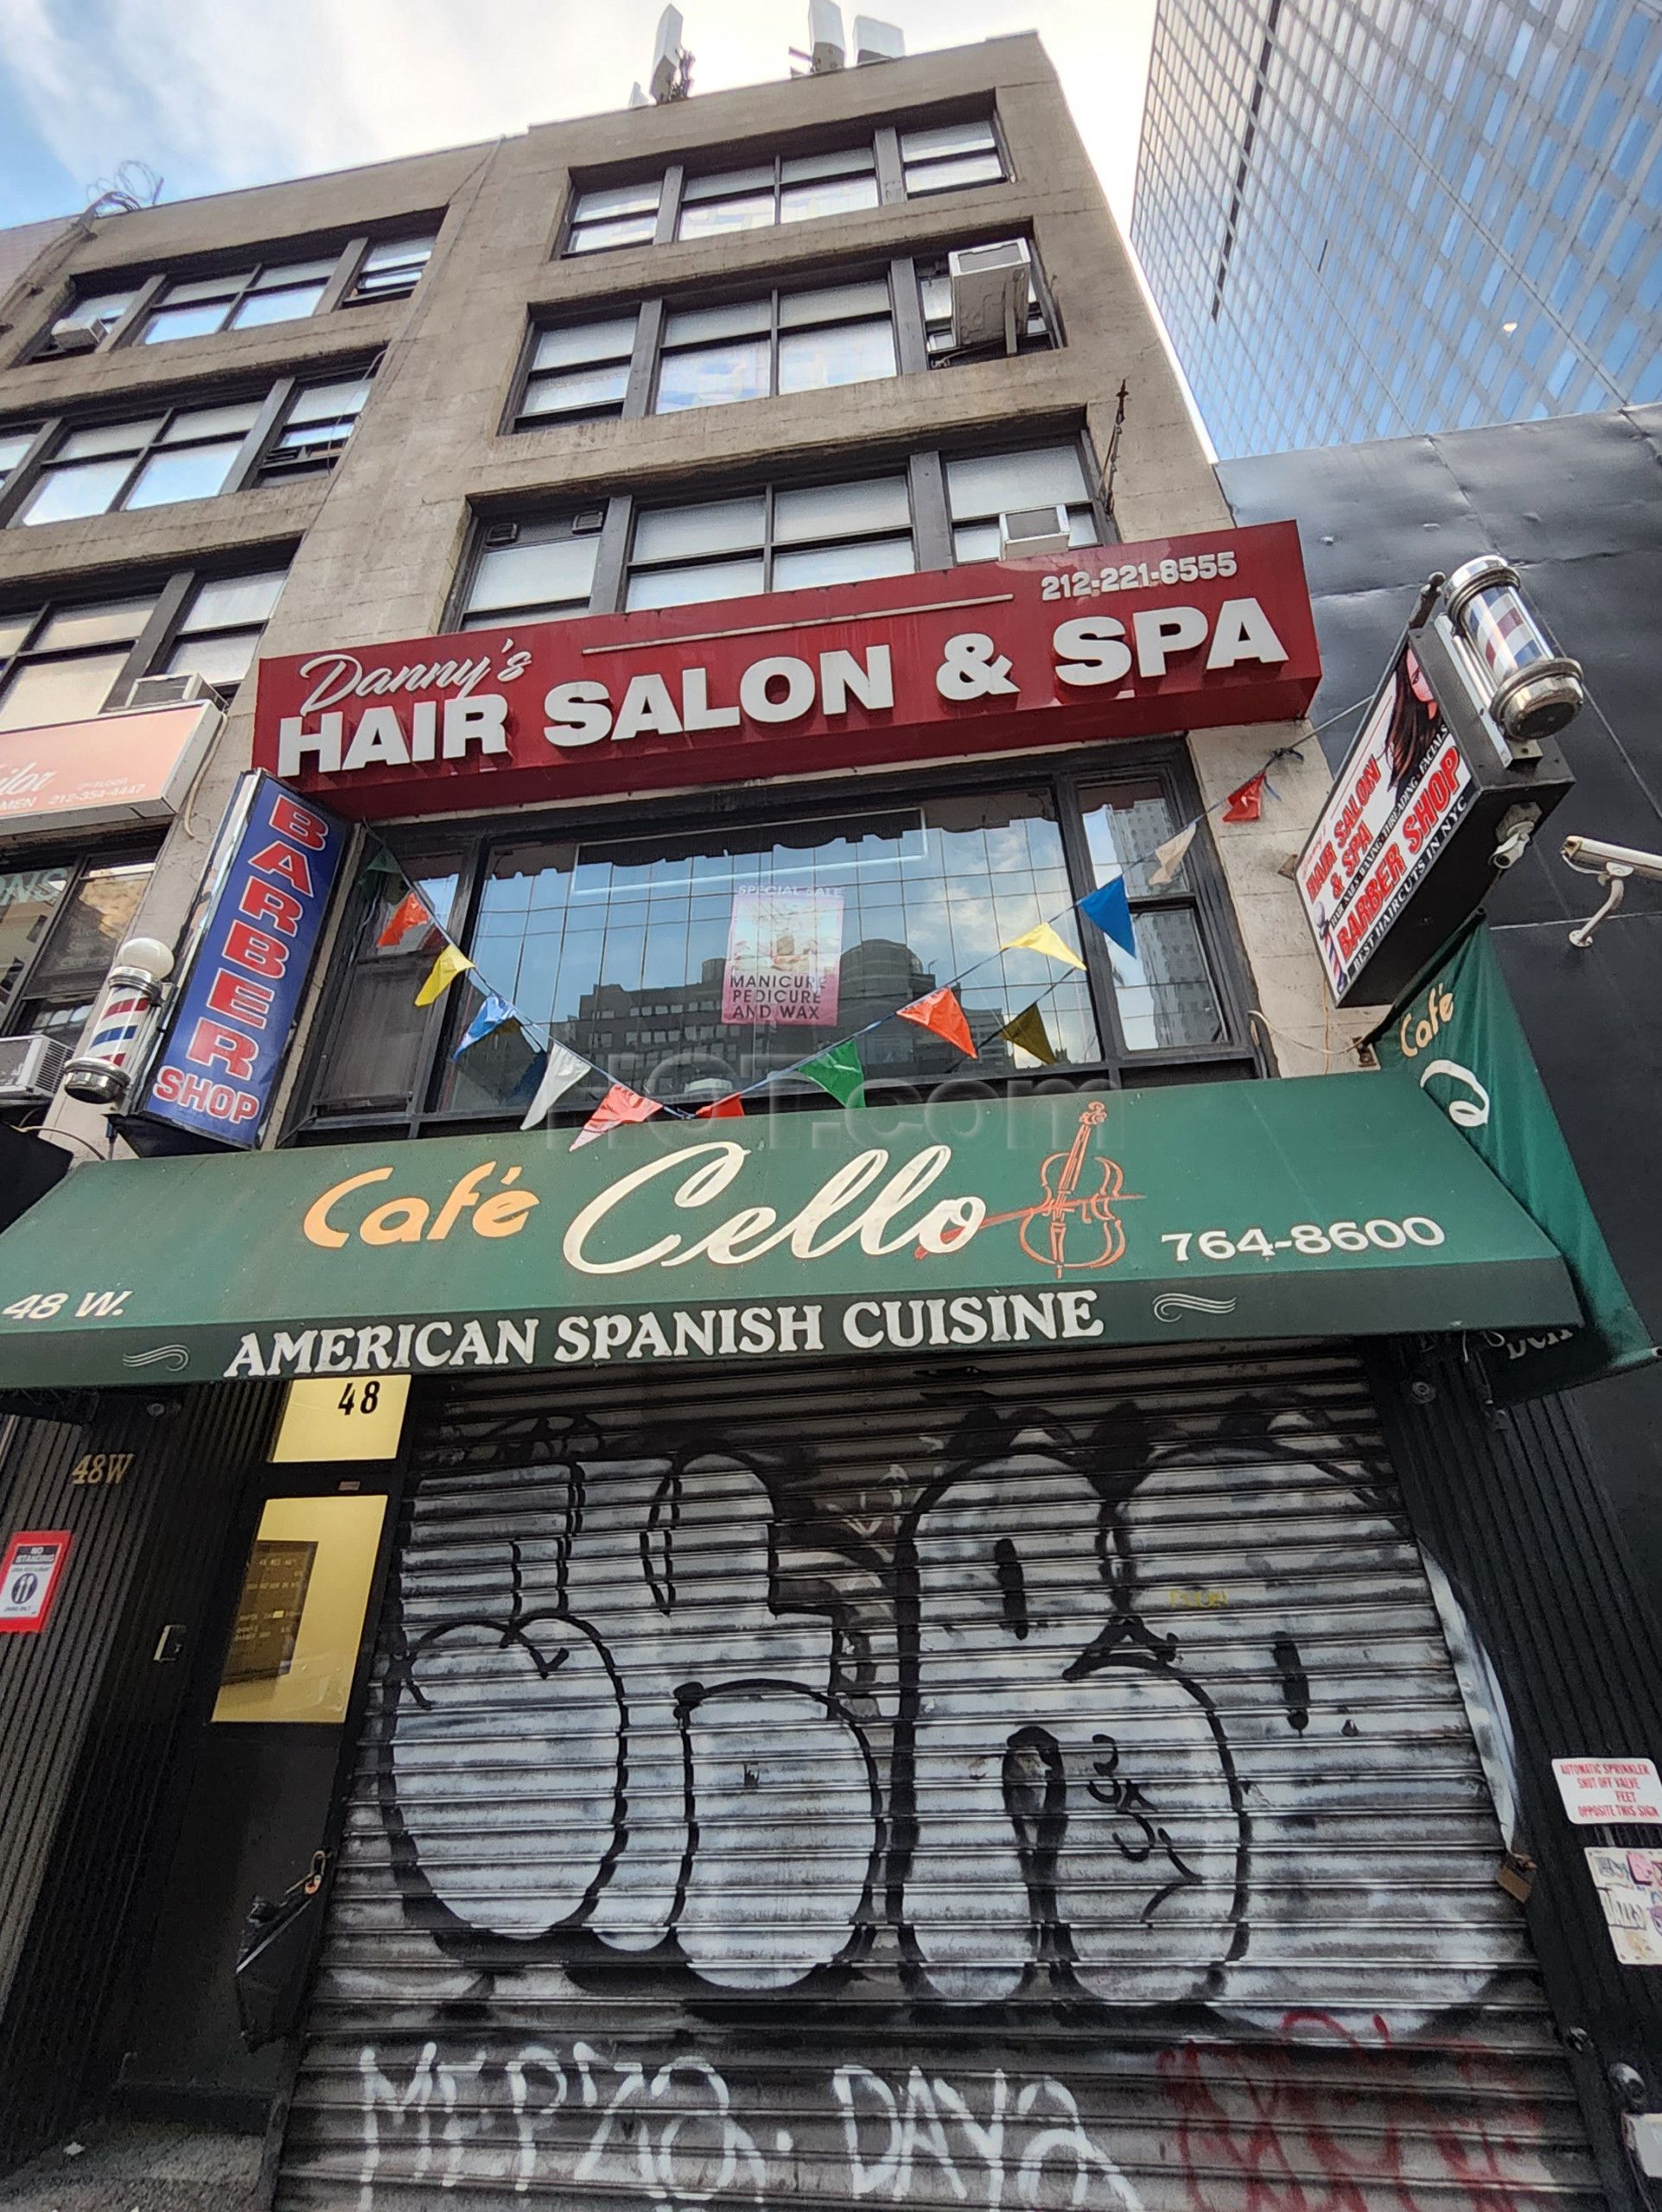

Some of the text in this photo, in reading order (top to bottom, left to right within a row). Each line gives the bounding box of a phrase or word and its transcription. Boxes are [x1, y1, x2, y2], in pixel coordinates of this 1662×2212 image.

[1041, 551, 1237, 601] 212-221-8555
[277, 597, 1289, 778] HAIR SALON & SPA
[300, 638, 532, 716] Danny's
[1418, 724, 1449, 775] FACIALS
[1306, 753, 1382, 905] HAIR SALON
[1331, 820, 1373, 899] & SPA
[1336, 746, 1461, 963] BARBER SHOP
[1353, 795, 1468, 970] BEST HAIRCUTS IN NYC
[186, 794, 328, 1081] BARBER
[733, 989, 822, 1004] PEDICURE
[733, 1004, 820, 1020] AND WAX
[1400, 982, 1454, 1058] Café
[153, 1065, 260, 1124] SHOP
[302, 1141, 986, 1274] Café Cello
[1161, 1217, 1445, 1262] 764-8600
[2, 1290, 132, 1320] 48 W.
[223, 1289, 1105, 1378] AMERICAN SPANISH CUISINE
[338, 1381, 380, 1415] 48
[72, 1454, 134, 1485] 48W
